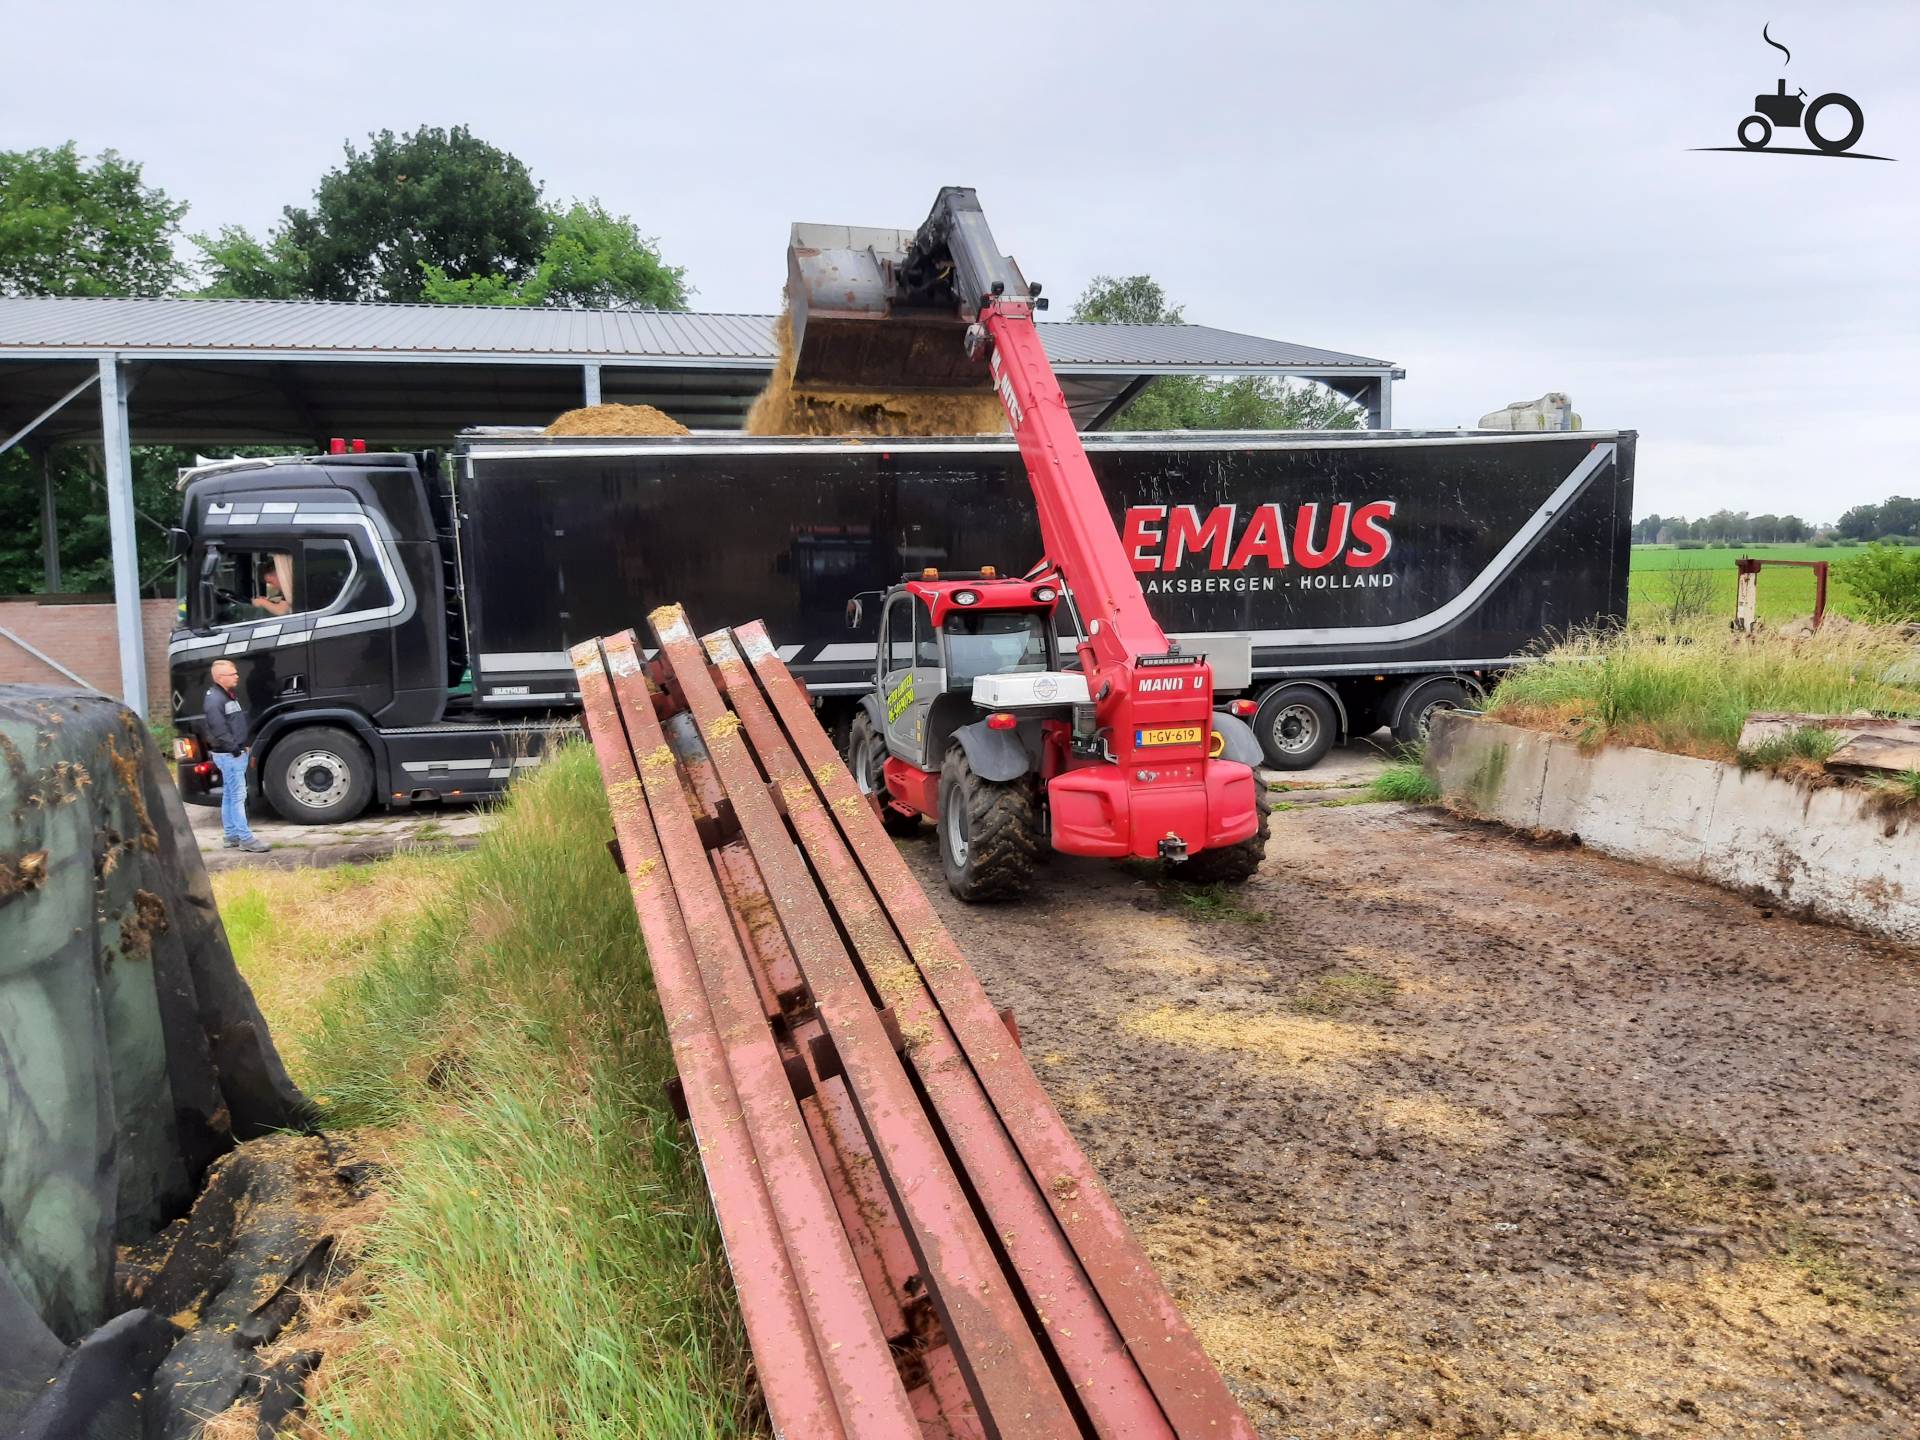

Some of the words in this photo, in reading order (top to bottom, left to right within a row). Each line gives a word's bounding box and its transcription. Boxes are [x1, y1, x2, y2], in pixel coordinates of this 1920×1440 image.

[1300, 573, 1394, 589] HOLLAND
[1139, 676, 1203, 692] MANITU
[1149, 730, 1194, 743] 1-GV-619
